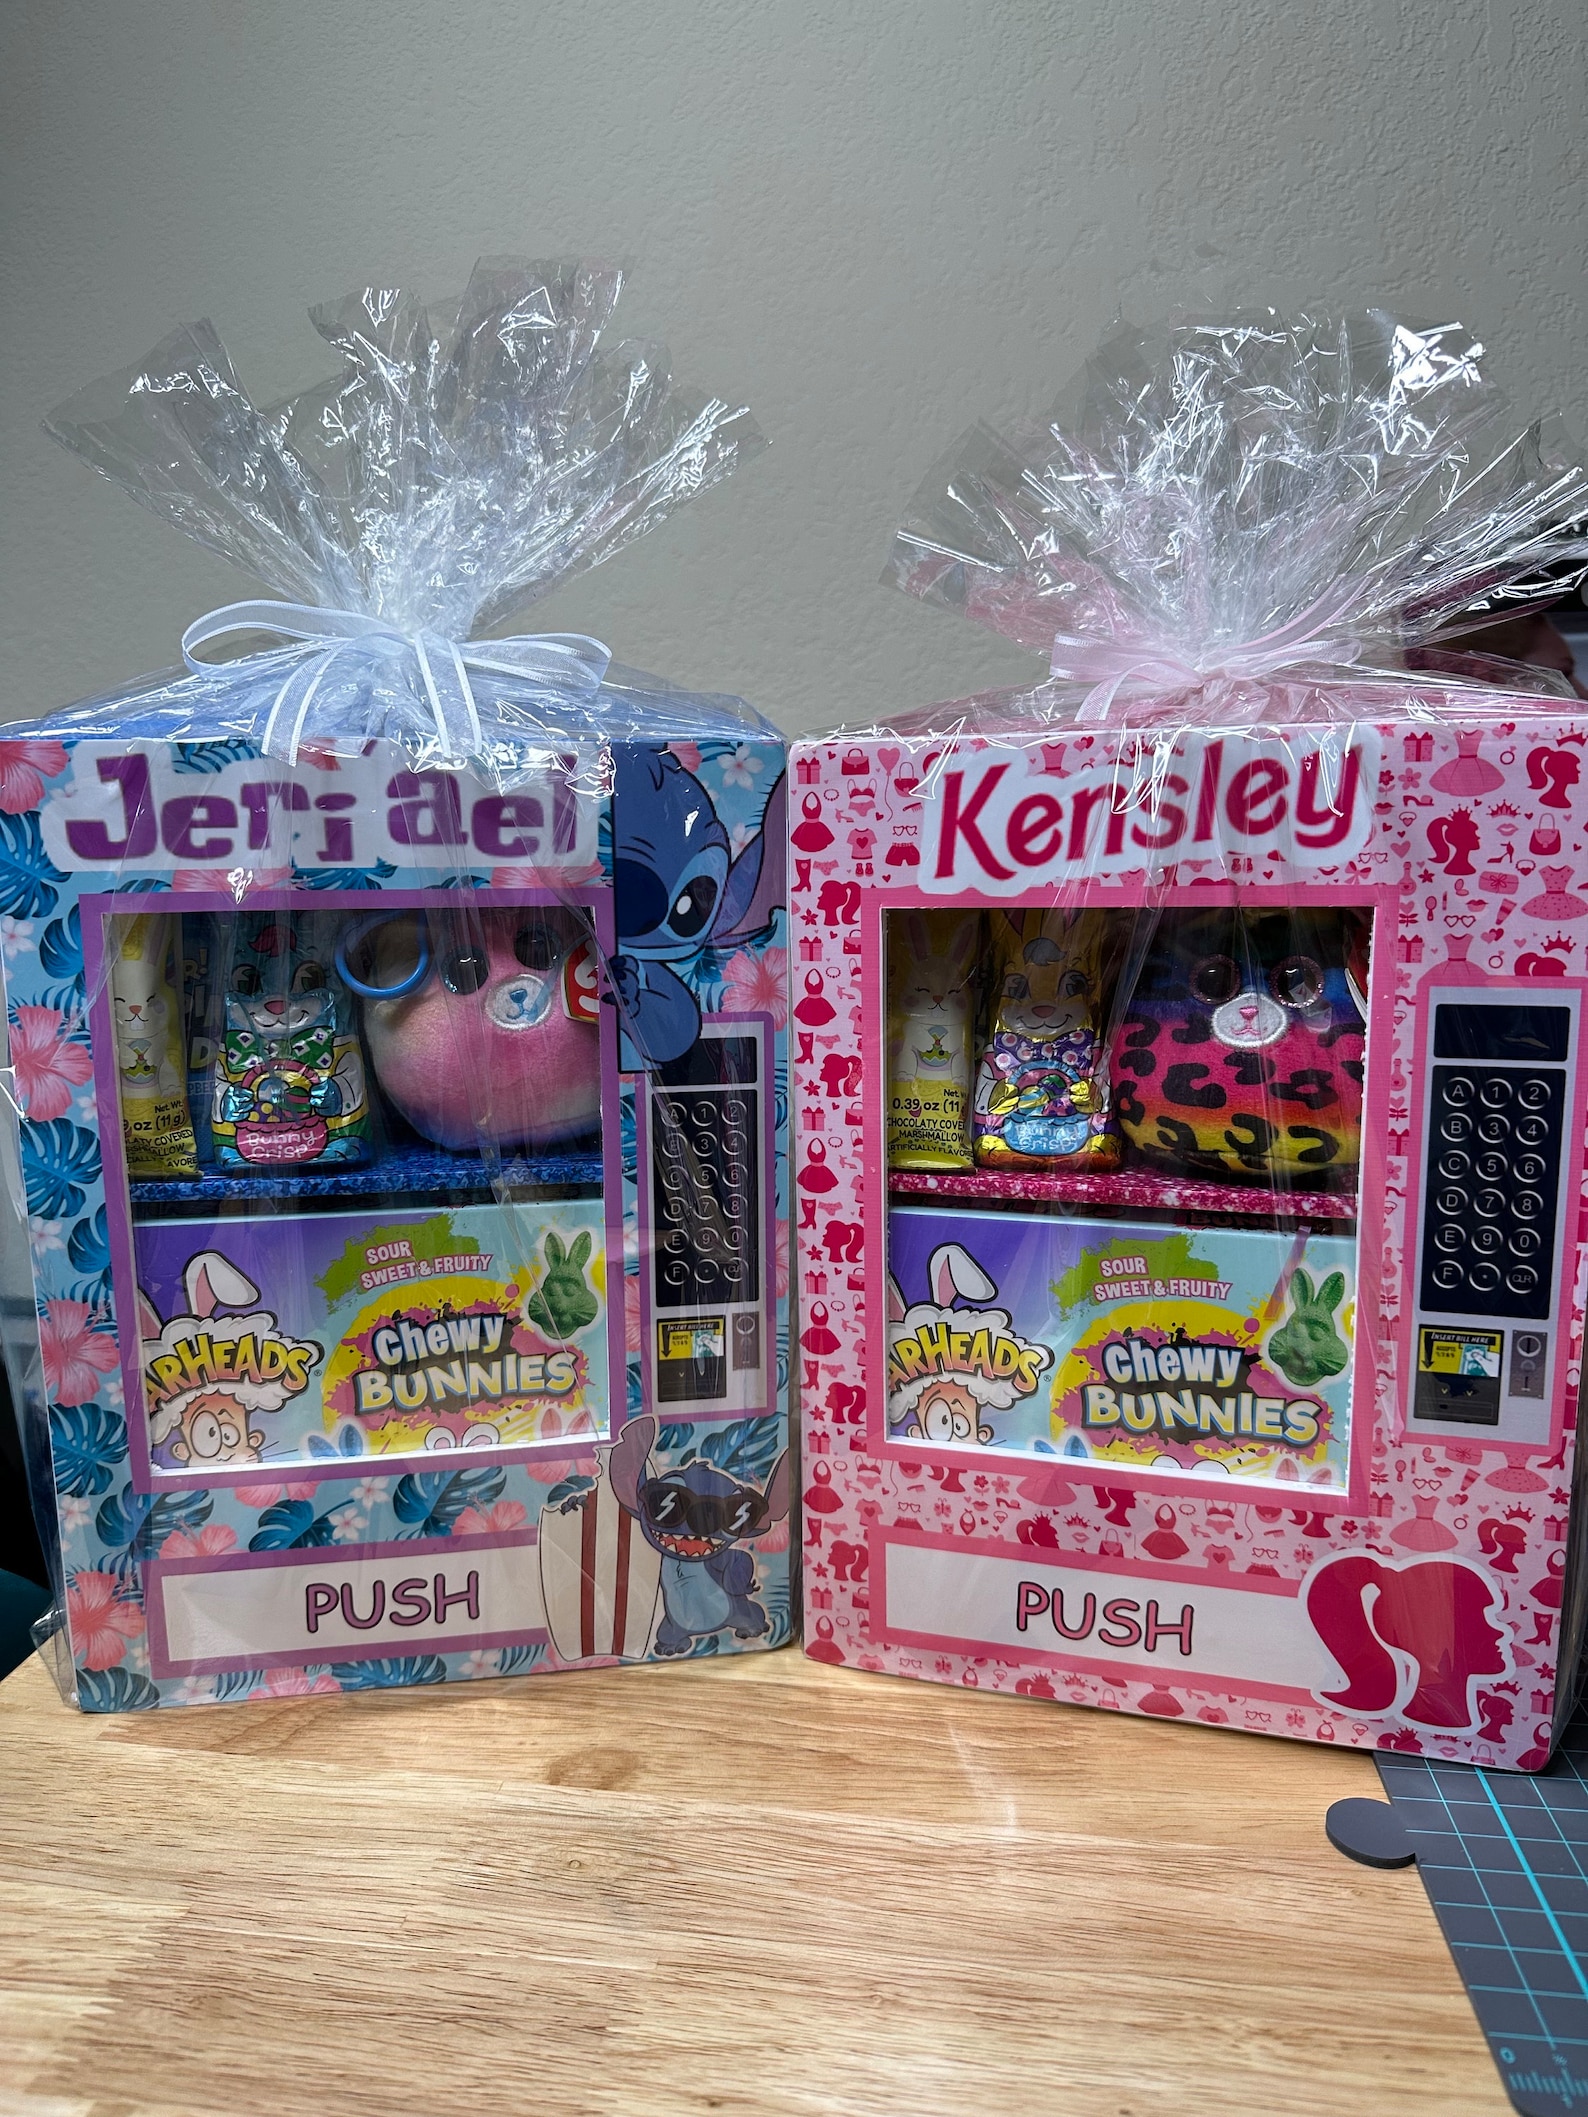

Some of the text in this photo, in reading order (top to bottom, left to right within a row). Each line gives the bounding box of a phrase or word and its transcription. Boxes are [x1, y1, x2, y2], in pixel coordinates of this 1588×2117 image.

[934, 738, 1363, 881] Kensley
[943, 1088, 959, 1097] Net
[1452, 1084, 1465, 1097] A
[1491, 1087, 1499, 1099] 1
[1529, 1087, 1539, 1100] 2
[154, 1104, 170, 1114] Net
[893, 1098, 920, 1110] 0.39
[923, 1102, 940, 1111] oz
[670, 1108, 679, 1119] A
[701, 1108, 707, 1119] 1
[730, 1106, 738, 1117] 2
[133, 1121, 153, 1131] oz
[1451, 1121, 1462, 1134] B
[1489, 1122, 1500, 1135] 3
[1526, 1124, 1537, 1136] 4
[245, 1128, 318, 1150] Bunny
[701, 1139, 709, 1149] 3
[730, 1137, 738, 1147] 4
[251, 1142, 309, 1161] Crisp
[1448, 1157, 1461, 1171] C
[1487, 1159, 1497, 1172] 5
[1524, 1161, 1535, 1175] 6
[701, 1170, 709, 1181] 5
[731, 1169, 738, 1180] 6
[702, 1202, 710, 1213] 7
[731, 1201, 739, 1212] 8
[1446, 1194, 1459, 1208] D
[1484, 1196, 1495, 1209] 7
[1522, 1198, 1532, 1212] 8
[671, 1203, 681, 1214] D
[672, 1235, 680, 1246] E
[702, 1233, 710, 1245] 9
[1445, 1230, 1456, 1243] E
[1482, 1232, 1492, 1246] 9
[1519, 1235, 1530, 1249] 0
[366, 1241, 412, 1264] SOUR
[360, 1254, 494, 1291] SWEET & FRUITY
[673, 1267, 680, 1278] F
[1101, 1257, 1147, 1277] SOUR
[1443, 1267, 1453, 1280] F
[1094, 1280, 1232, 1301] SWEET & FRUITY
[373, 1314, 506, 1364] Chewy
[1103, 1339, 1241, 1388] Chewy
[357, 1353, 578, 1414] BUNNIES
[1082, 1383, 1320, 1442] BUNNIES
[306, 1570, 480, 1633] PUSH
[1017, 1581, 1194, 1656] PUSH
